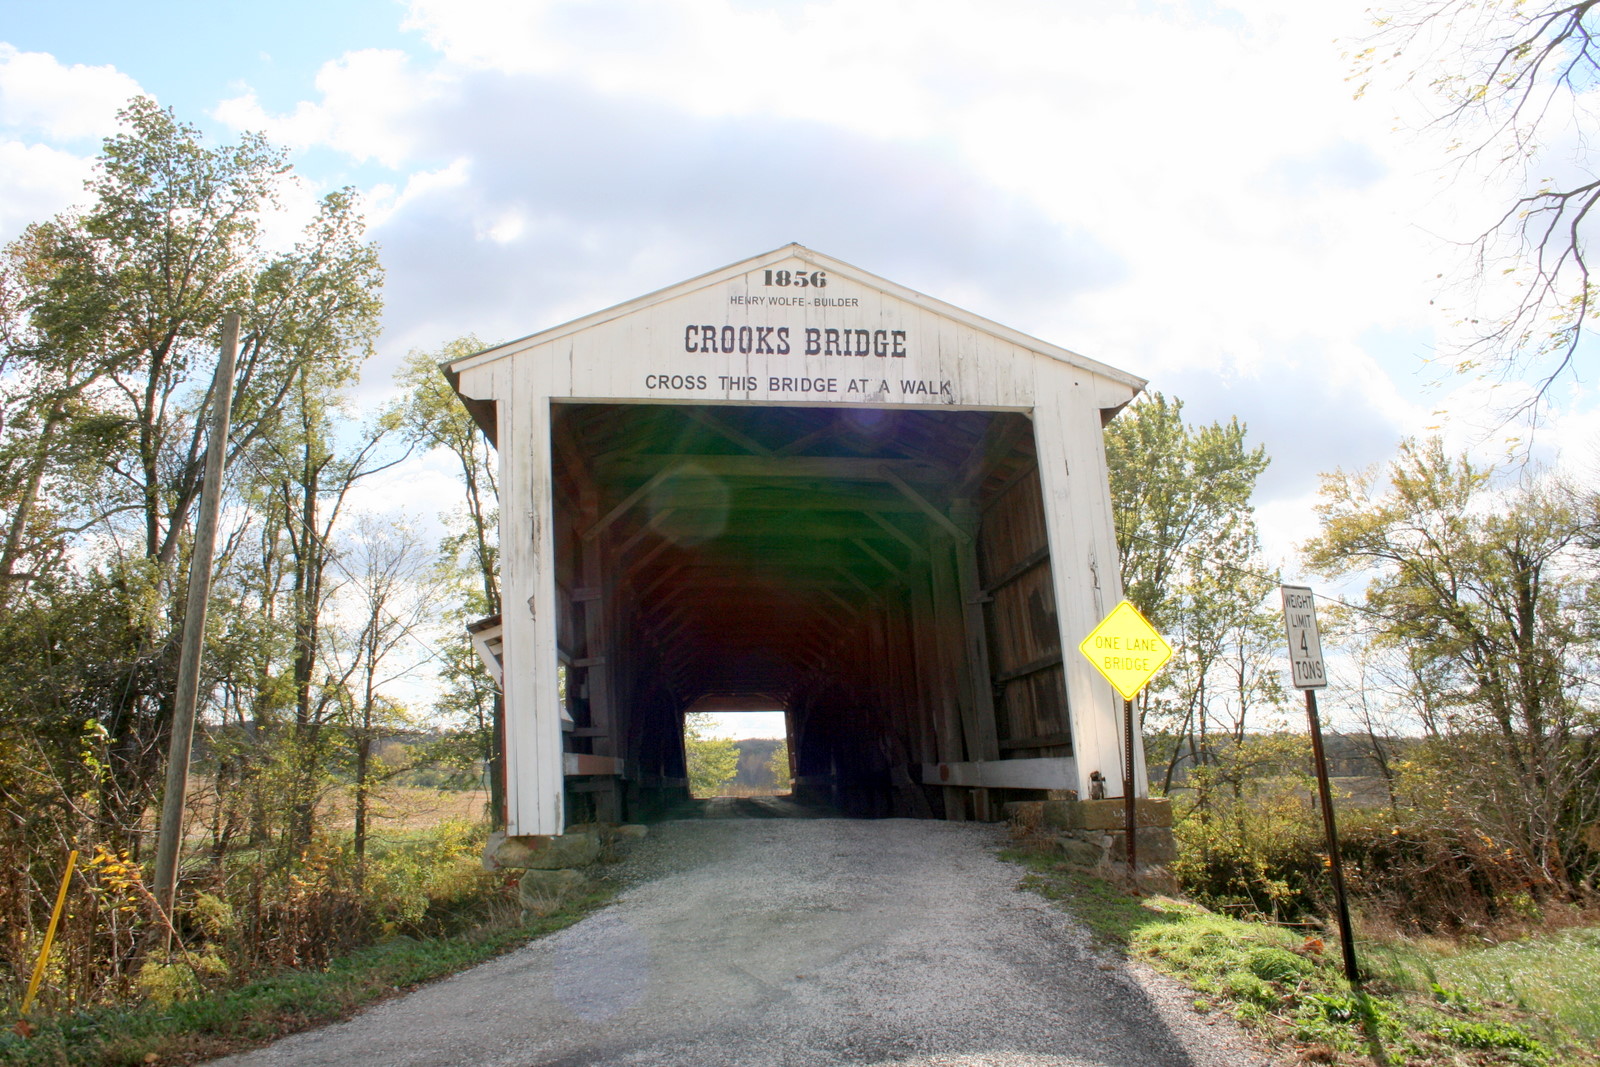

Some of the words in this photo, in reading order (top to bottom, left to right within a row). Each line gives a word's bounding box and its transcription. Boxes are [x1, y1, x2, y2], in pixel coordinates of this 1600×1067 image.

[762, 269, 827, 288] 1856
[730, 295, 766, 305] HENRY
[769, 296, 805, 306] WOLFE
[814, 297, 859, 307] BUILDER
[684, 324, 791, 355] CROOKS
[805, 328, 907, 358] BRIDGE
[645, 375, 707, 390] CROSS
[718, 376, 758, 391] THIS
[769, 377, 837, 393] BRIDGE
[847, 379, 868, 393] AT
[878, 379, 890, 394] A
[900, 380, 950, 395] WALK
[1285, 593, 1314, 610] WEIGHT
[1290, 614, 1312, 629] LIMIT
[1095, 636, 1120, 649] ONE
[1126, 637, 1158, 652] LANE
[1300, 629, 1308, 657] 4
[1104, 656, 1151, 672] BRIDGE
[1295, 661, 1323, 680] TONS
